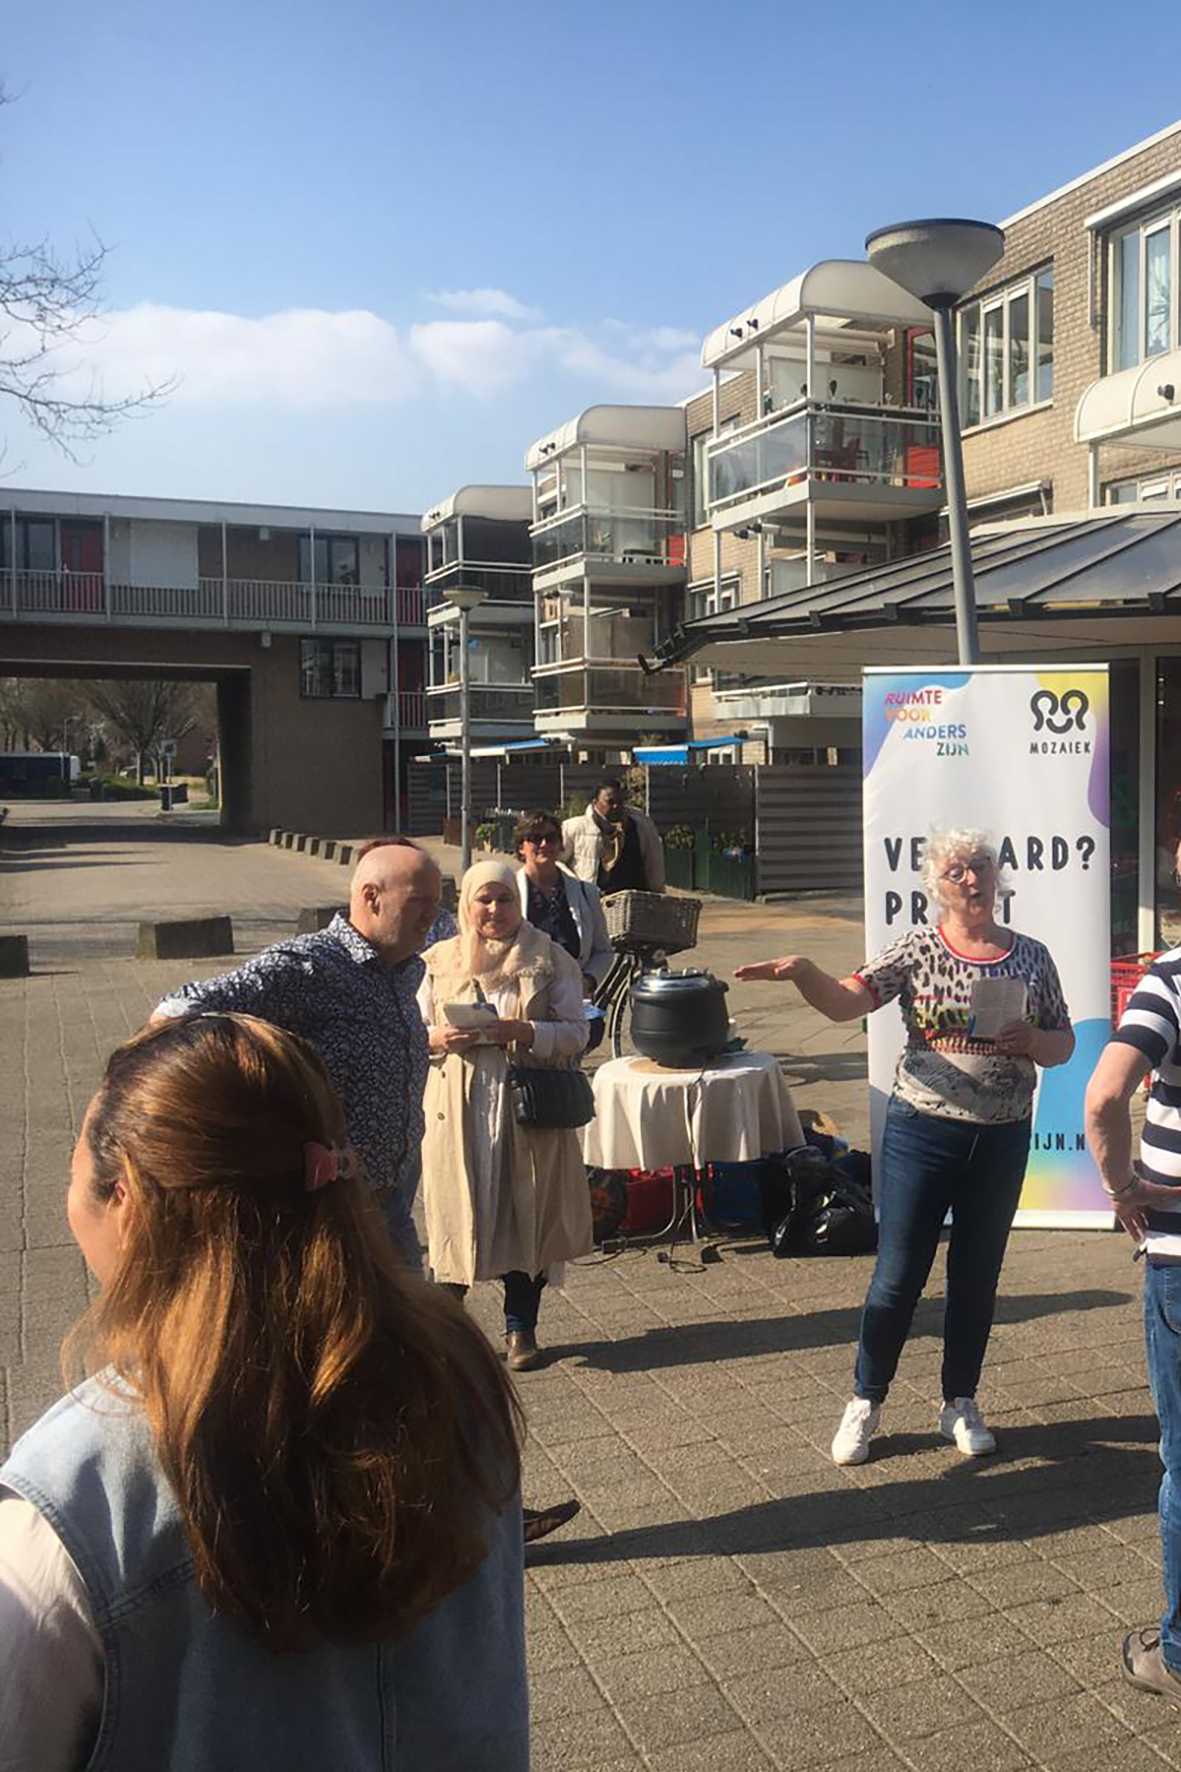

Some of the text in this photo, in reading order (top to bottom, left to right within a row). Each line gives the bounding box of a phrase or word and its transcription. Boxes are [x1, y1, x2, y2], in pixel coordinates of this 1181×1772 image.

[885, 690, 942, 705] RUIMTE
[886, 708, 930, 722] VOOR
[903, 724, 967, 739] ANDERS
[937, 742, 969, 756] ZIJN
[1029, 742, 1091, 754] MOZAIEK
[884, 836, 1095, 871] VEARD?
[886, 891, 1016, 925] PRT
